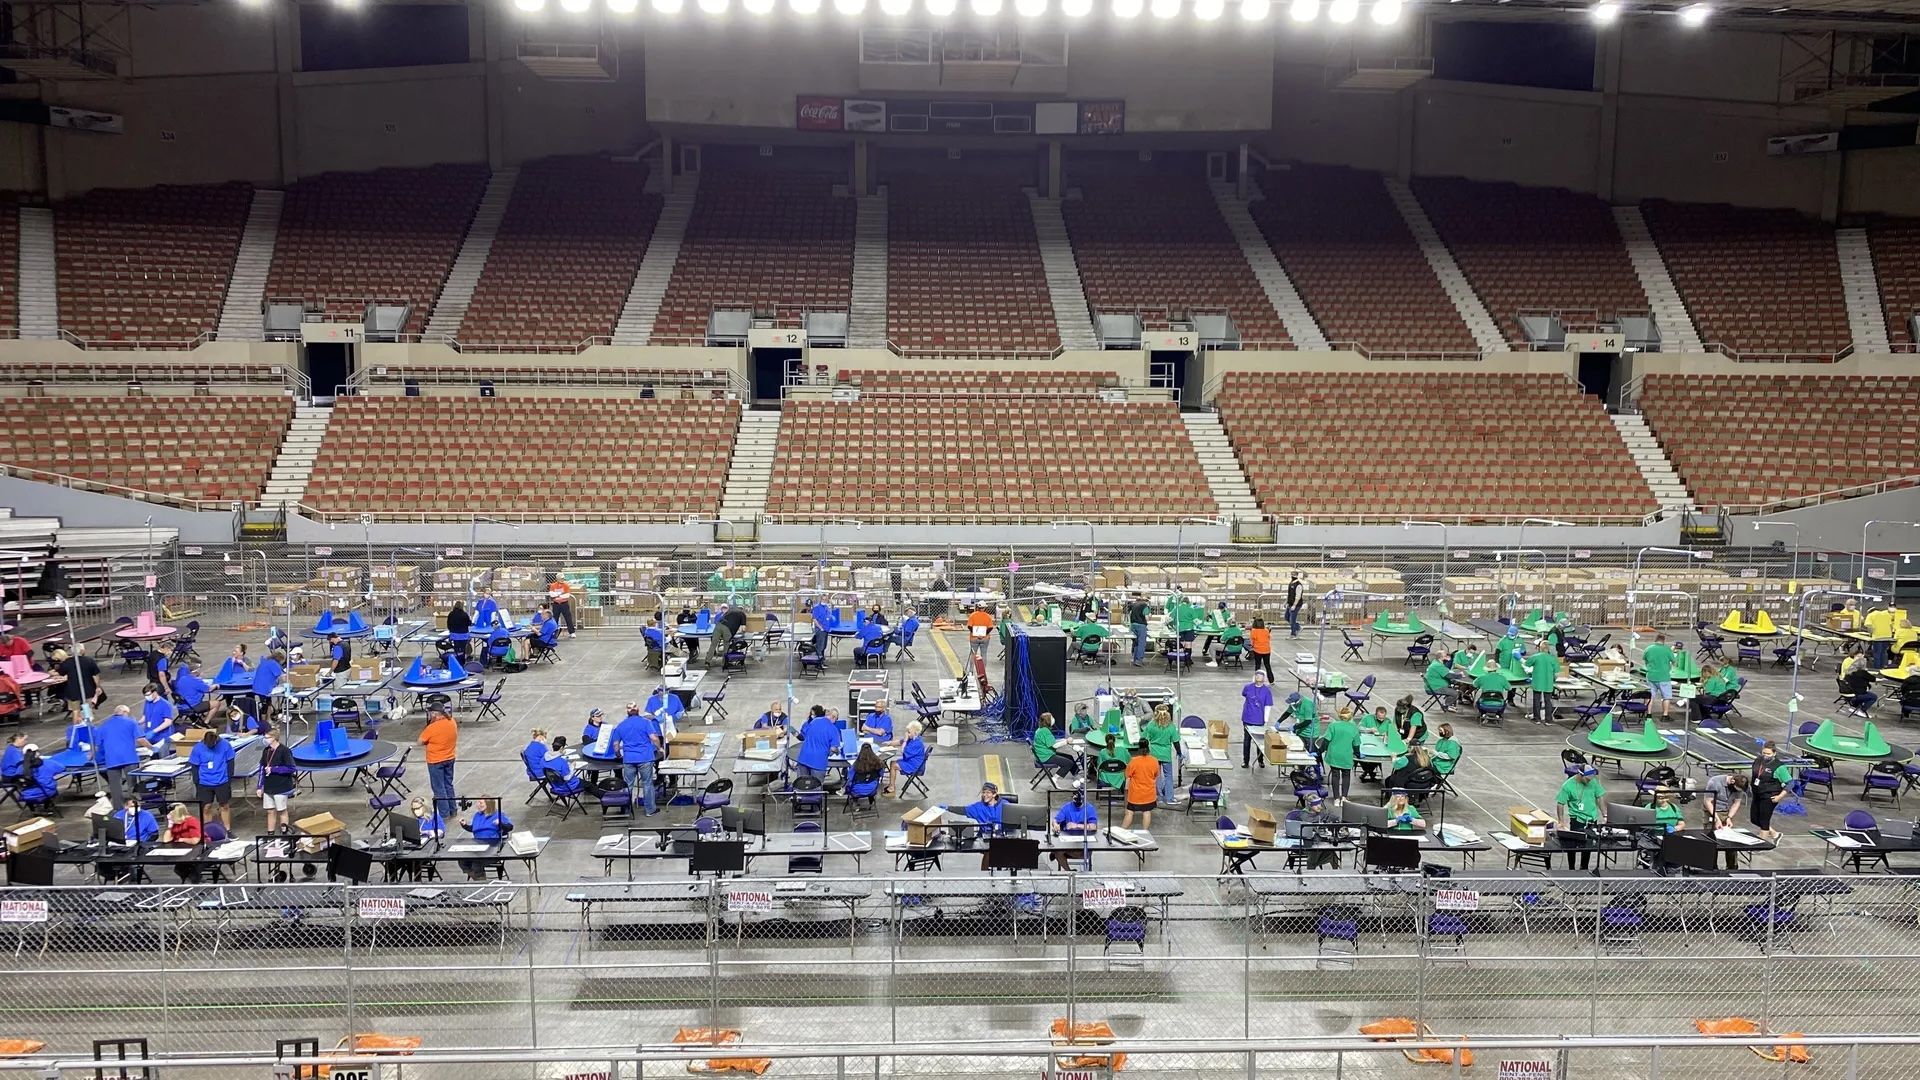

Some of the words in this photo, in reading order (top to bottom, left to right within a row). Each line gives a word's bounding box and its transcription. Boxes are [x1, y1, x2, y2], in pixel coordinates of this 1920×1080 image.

[344, 328, 354, 338] 11
[786, 334, 797, 343] 12
[1178, 337, 1189, 346] 13
[1604, 339, 1615, 348] 14
[729, 892, 771, 902] NATIONAL
[1084, 888, 1124, 898] NATIONAL
[1438, 890, 1478, 901] NATIONAL
[2, 902, 46, 912] NATIONAL
[361, 899, 403, 909] NATIONAL
[1500, 1061, 1551, 1073] NATIONAL
[1041, 1071, 1093, 1080] NTIONAL
